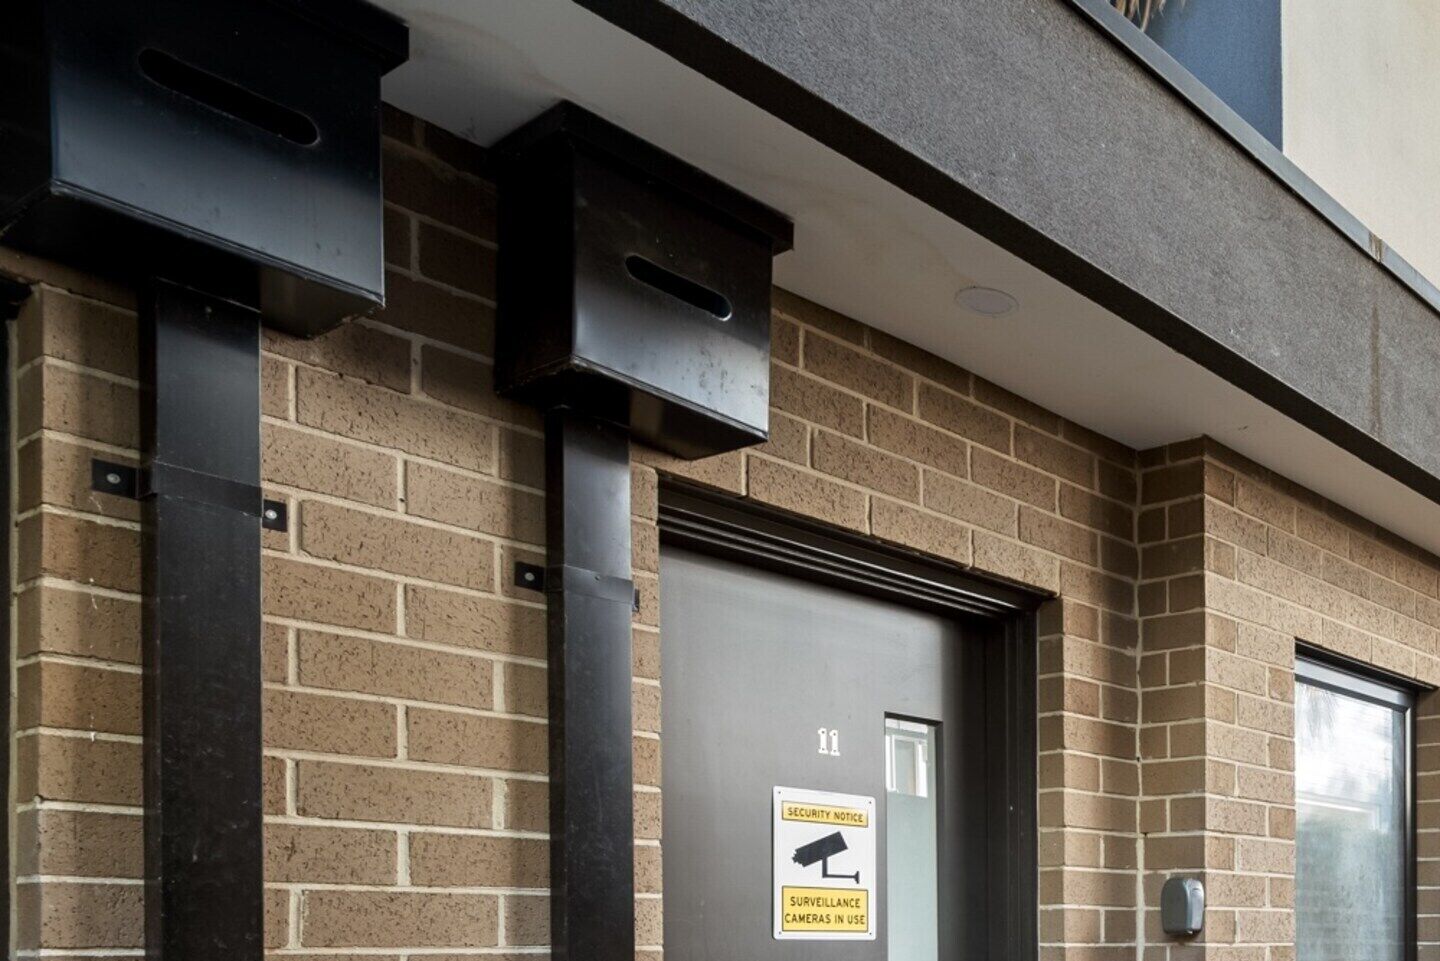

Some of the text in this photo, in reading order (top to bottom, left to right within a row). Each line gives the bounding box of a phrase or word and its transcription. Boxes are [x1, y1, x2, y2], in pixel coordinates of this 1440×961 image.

[818, 727, 841, 756] 11
[787, 806, 864, 823] SECURITY NOTICE
[790, 896, 861, 909] SURVEILLANCE
[784, 913, 865, 925] CAMERAS IN USE
